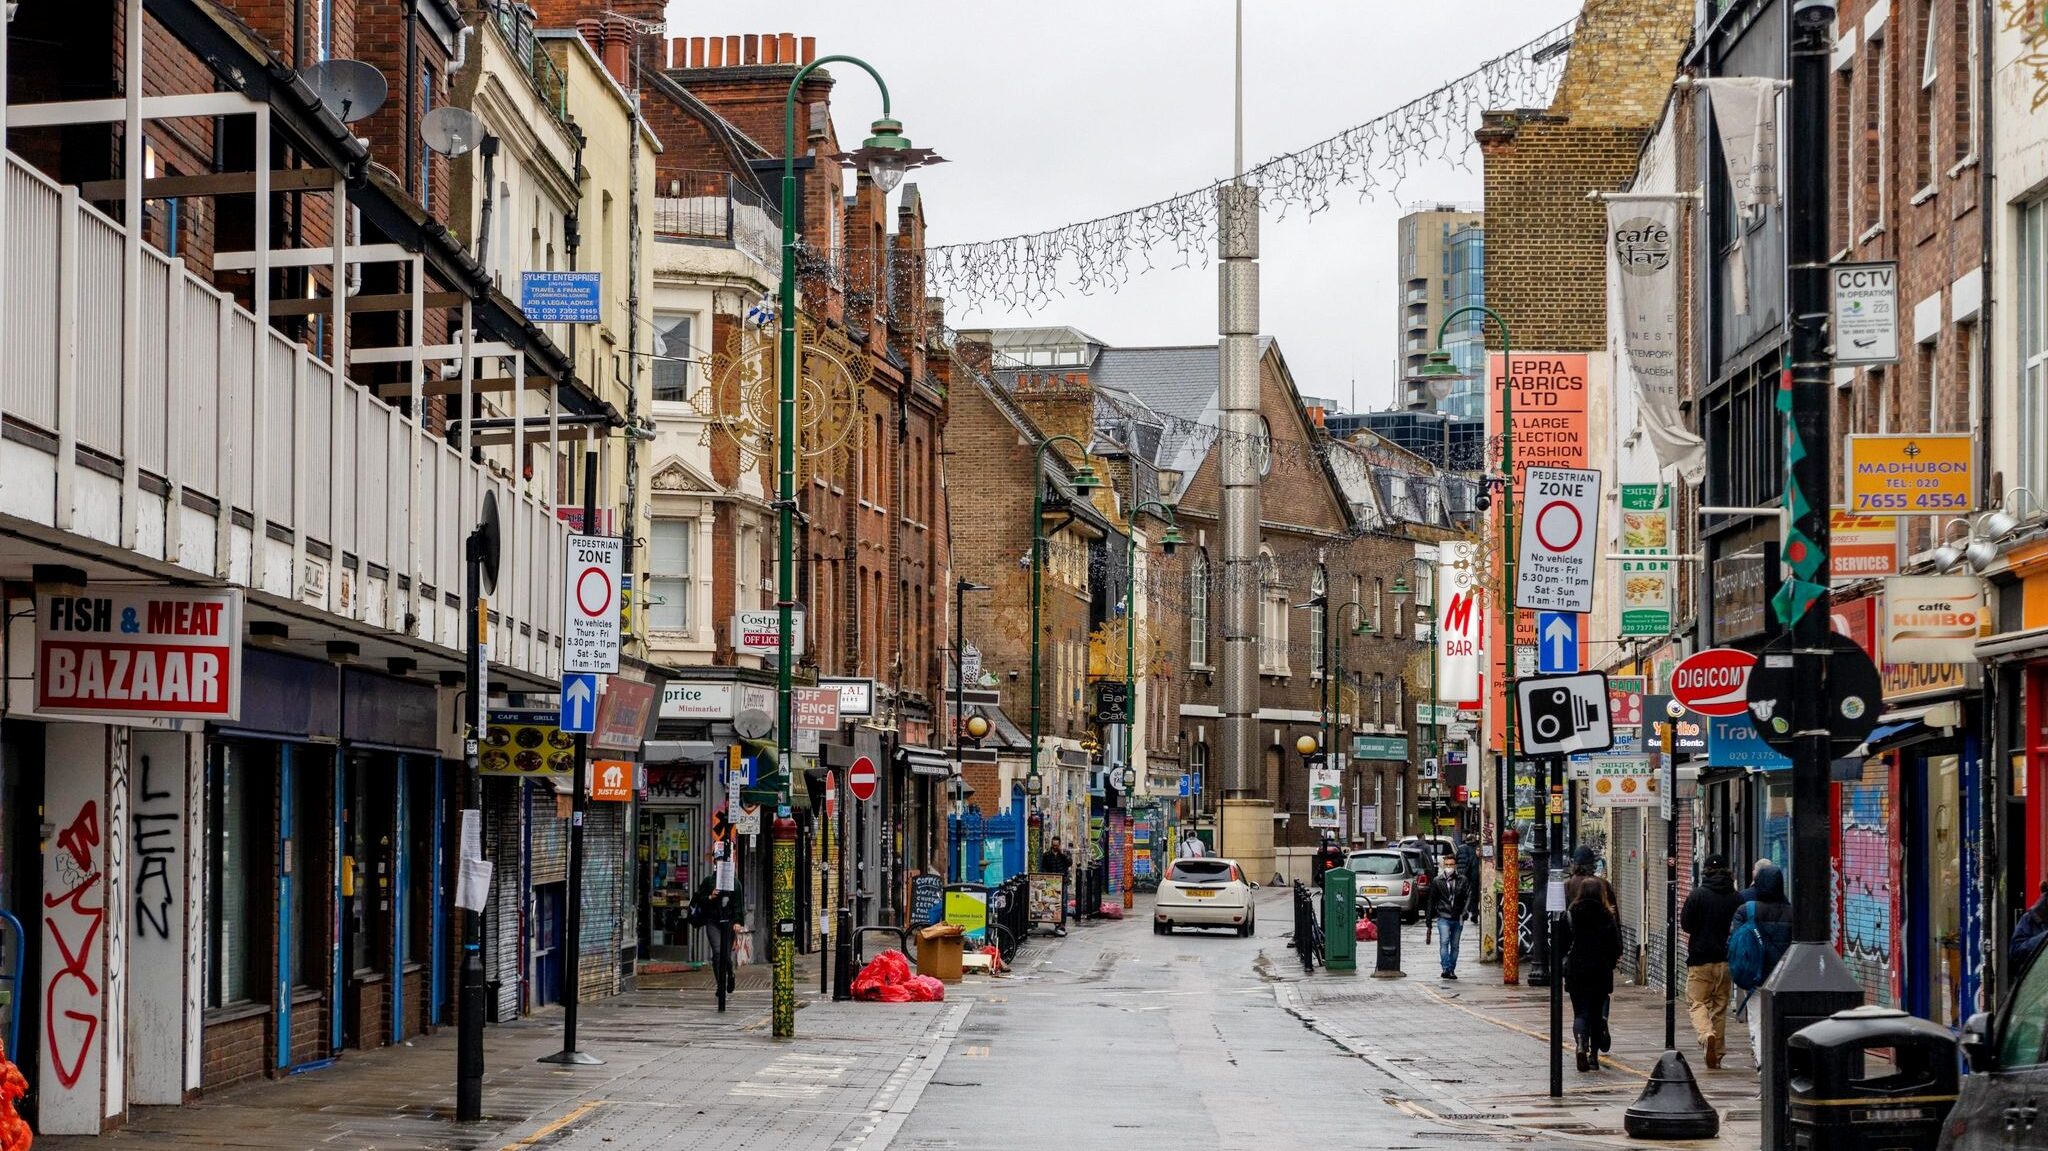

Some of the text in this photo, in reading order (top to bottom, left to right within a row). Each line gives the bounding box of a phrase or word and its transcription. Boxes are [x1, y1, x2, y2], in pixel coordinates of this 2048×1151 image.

[1616, 225, 1668, 242] café
[1838, 270, 1891, 288] CCTV
[1848, 290, 1893, 298] OPERATION
[1873, 304, 1889, 313] 223
[1512, 361, 1566, 374] EPRA
[1496, 377, 1582, 390] FABRICS
[1520, 392, 1557, 406] LTD
[1523, 418, 1569, 428] LARGE
[1518, 446, 1582, 457] FASHION
[1858, 462, 1967, 474] MADHUBON
[1532, 471, 1594, 482] PEDESTRIAN
[1886, 479, 1939, 488] TEL: 020
[1540, 483, 1583, 497] ZONE
[1859, 494, 1967, 508] 7655 4554
[572, 539, 618, 549] PEDESTRIAN
[578, 550, 611, 564] ZONE
[1531, 553, 1583, 564] No vehicles
[1534, 564, 1559, 573] Thurs
[1566, 566, 1578, 574] Fri
[1623, 562, 1668, 571] GAON
[1835, 556, 1888, 572] SERVICES
[1522, 573, 1543, 582] 5.30
[1545, 575, 1558, 584] pm
[1575, 578, 1589, 586] pm
[1534, 585, 1550, 594] Sat
[1557, 587, 1575, 596] Sun
[1566, 599, 1580, 607] pm
[1918, 602, 1951, 611] caffè
[50, 598, 224, 636] FISH & MEAT
[742, 614, 798, 628] Costpe
[1893, 612, 1975, 626] KIMBO
[586, 619, 612, 628] vehicles
[576, 628, 595, 637] Thurs
[568, 638, 584, 646] 5.30
[744, 636, 760, 644] OFF
[577, 649, 589, 658] Sat
[594, 650, 606, 658] Sun
[1446, 640, 1473, 656] BAR
[48, 647, 219, 703] BAZAAR
[1678, 666, 1740, 688] DIGICOM
[798, 691, 820, 700] OFF
[798, 703, 835, 715] ENCE
[799, 715, 824, 724] PEN
[1716, 724, 1758, 740] Trav
